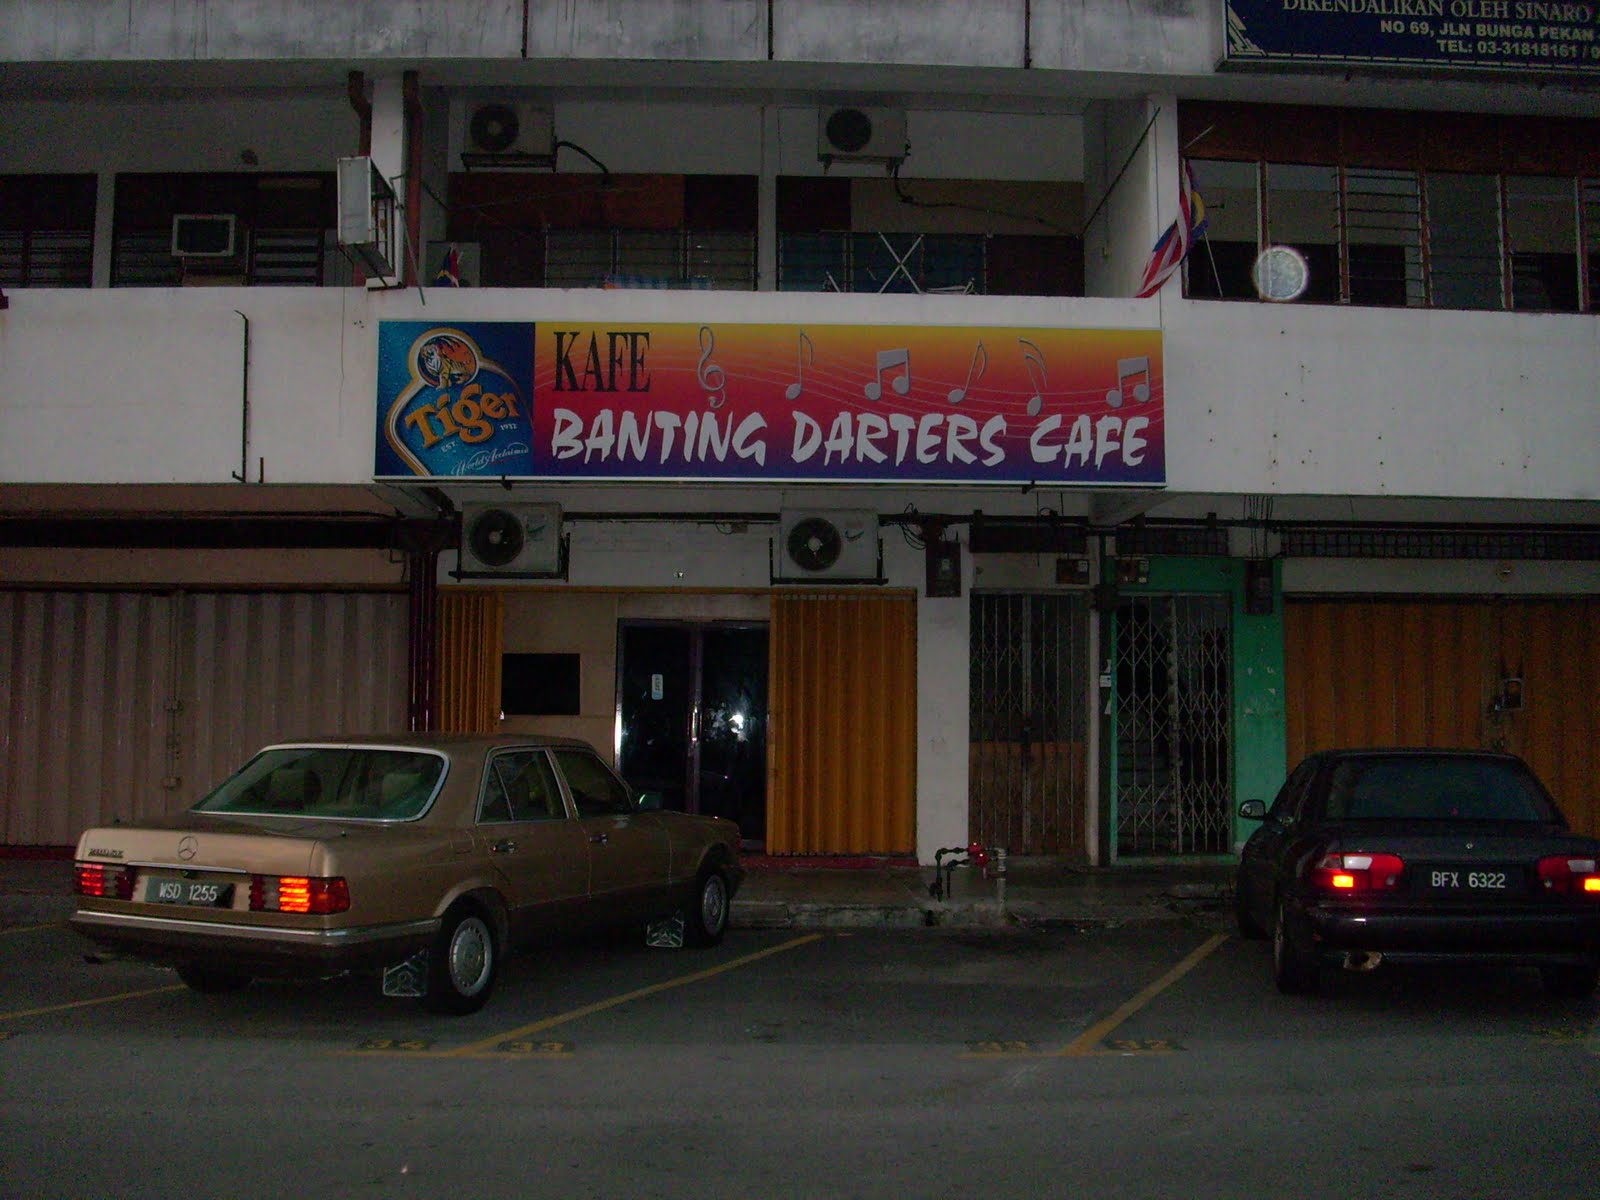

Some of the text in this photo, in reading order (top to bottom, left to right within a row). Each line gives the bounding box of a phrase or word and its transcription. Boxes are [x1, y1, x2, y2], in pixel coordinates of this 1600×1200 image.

[1283, 0, 1592, 22] DIKENDALIKAN OLEH SINARO
[1380, 20, 1595, 41] NO 69, JLN BUNGA PEKAN
[1436, 39, 1473, 53] TEL:
[1477, 40, 1578, 58] 03-31818161
[552, 331, 650, 392] KAFE
[404, 383, 520, 448] Tiger
[551, 408, 1150, 470] BANTING DARTERS CAFE
[1431, 871, 1506, 888] BFX 6322
[159, 882, 218, 901] WSD 1255
